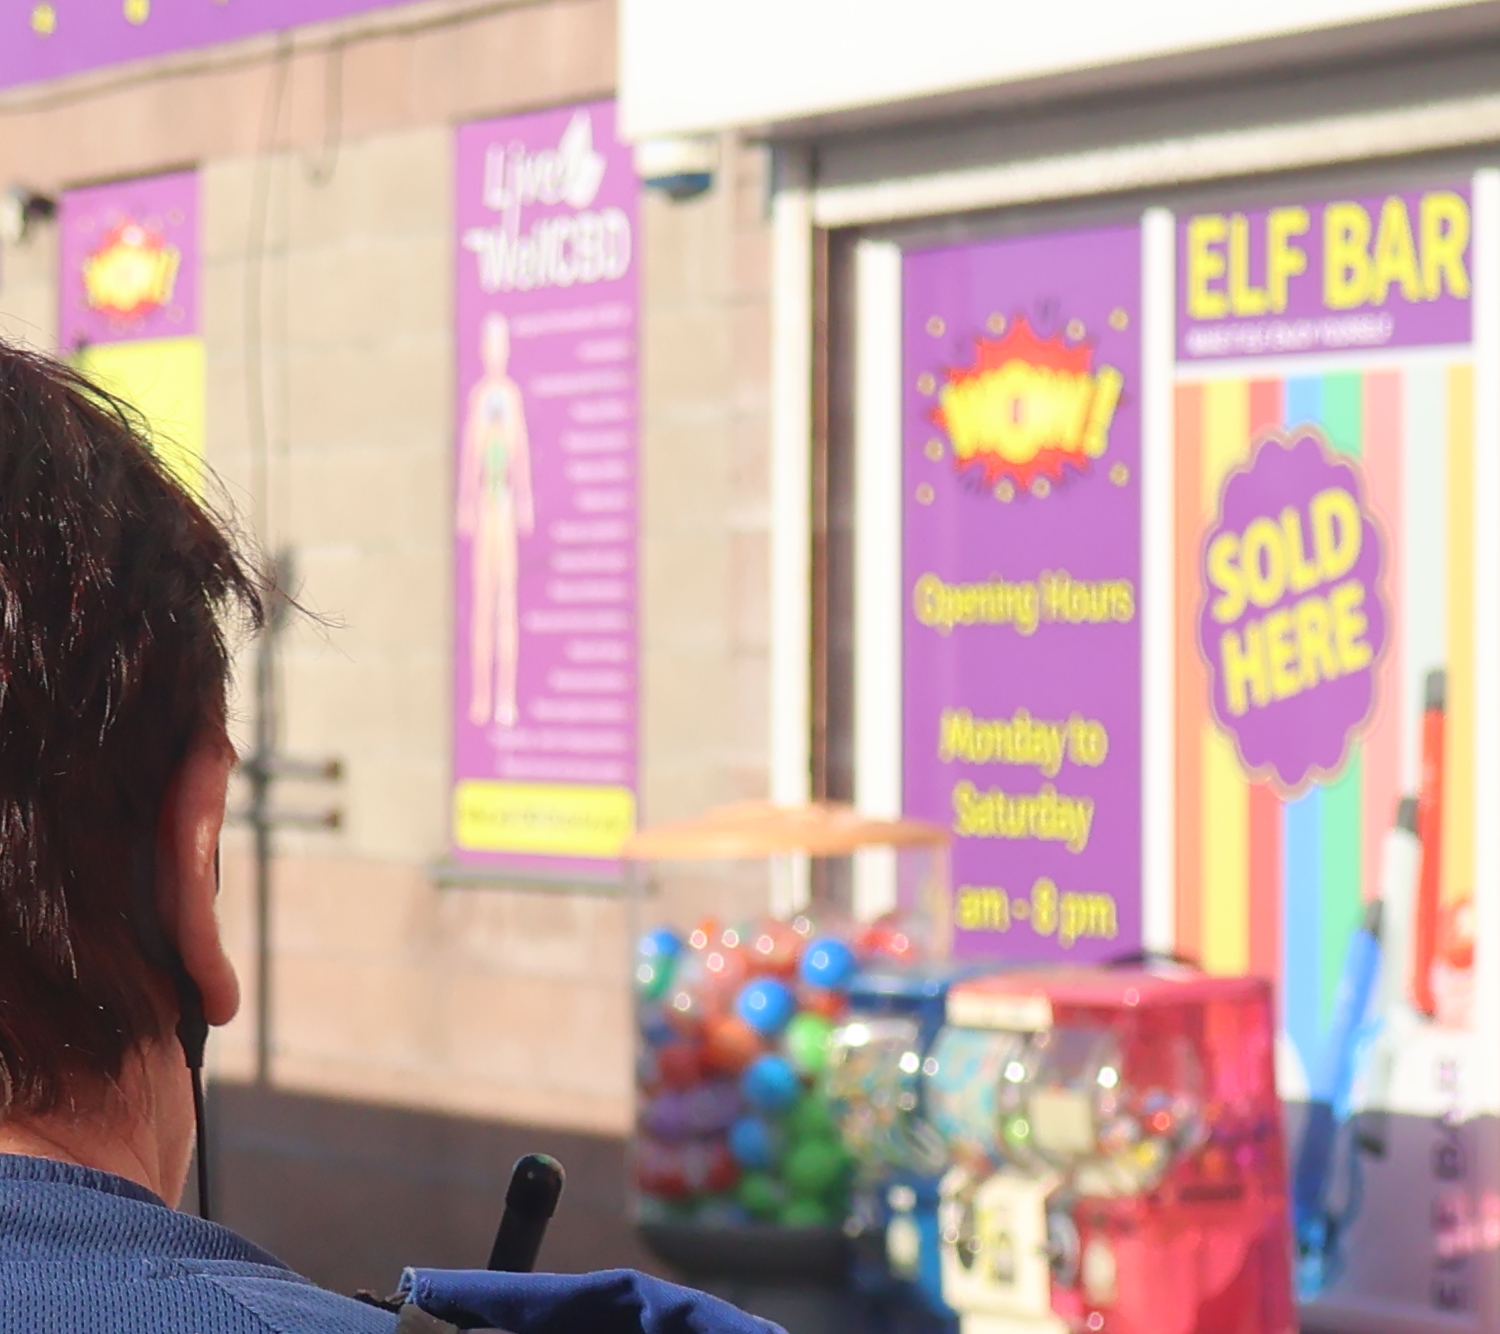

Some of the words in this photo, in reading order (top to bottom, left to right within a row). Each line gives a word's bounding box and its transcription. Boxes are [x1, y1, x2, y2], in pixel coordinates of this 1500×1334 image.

[1187, 207, 1310, 319] ELF
[1322, 190, 1473, 310] BAR
[938, 358, 1124, 464] WOW!
[1207, 487, 1363, 624] SOLD
[913, 572, 1039, 637] Opening
[1039, 568, 1136, 624] Hours
[1221, 578, 1373, 717] HERE
[939, 706, 1067, 778] Monday
[1067, 711, 1109, 768] to
[953, 779, 1094, 854] Saturday
[1030, 877, 1059, 937] 8
[1059, 891, 1118, 949] pm
